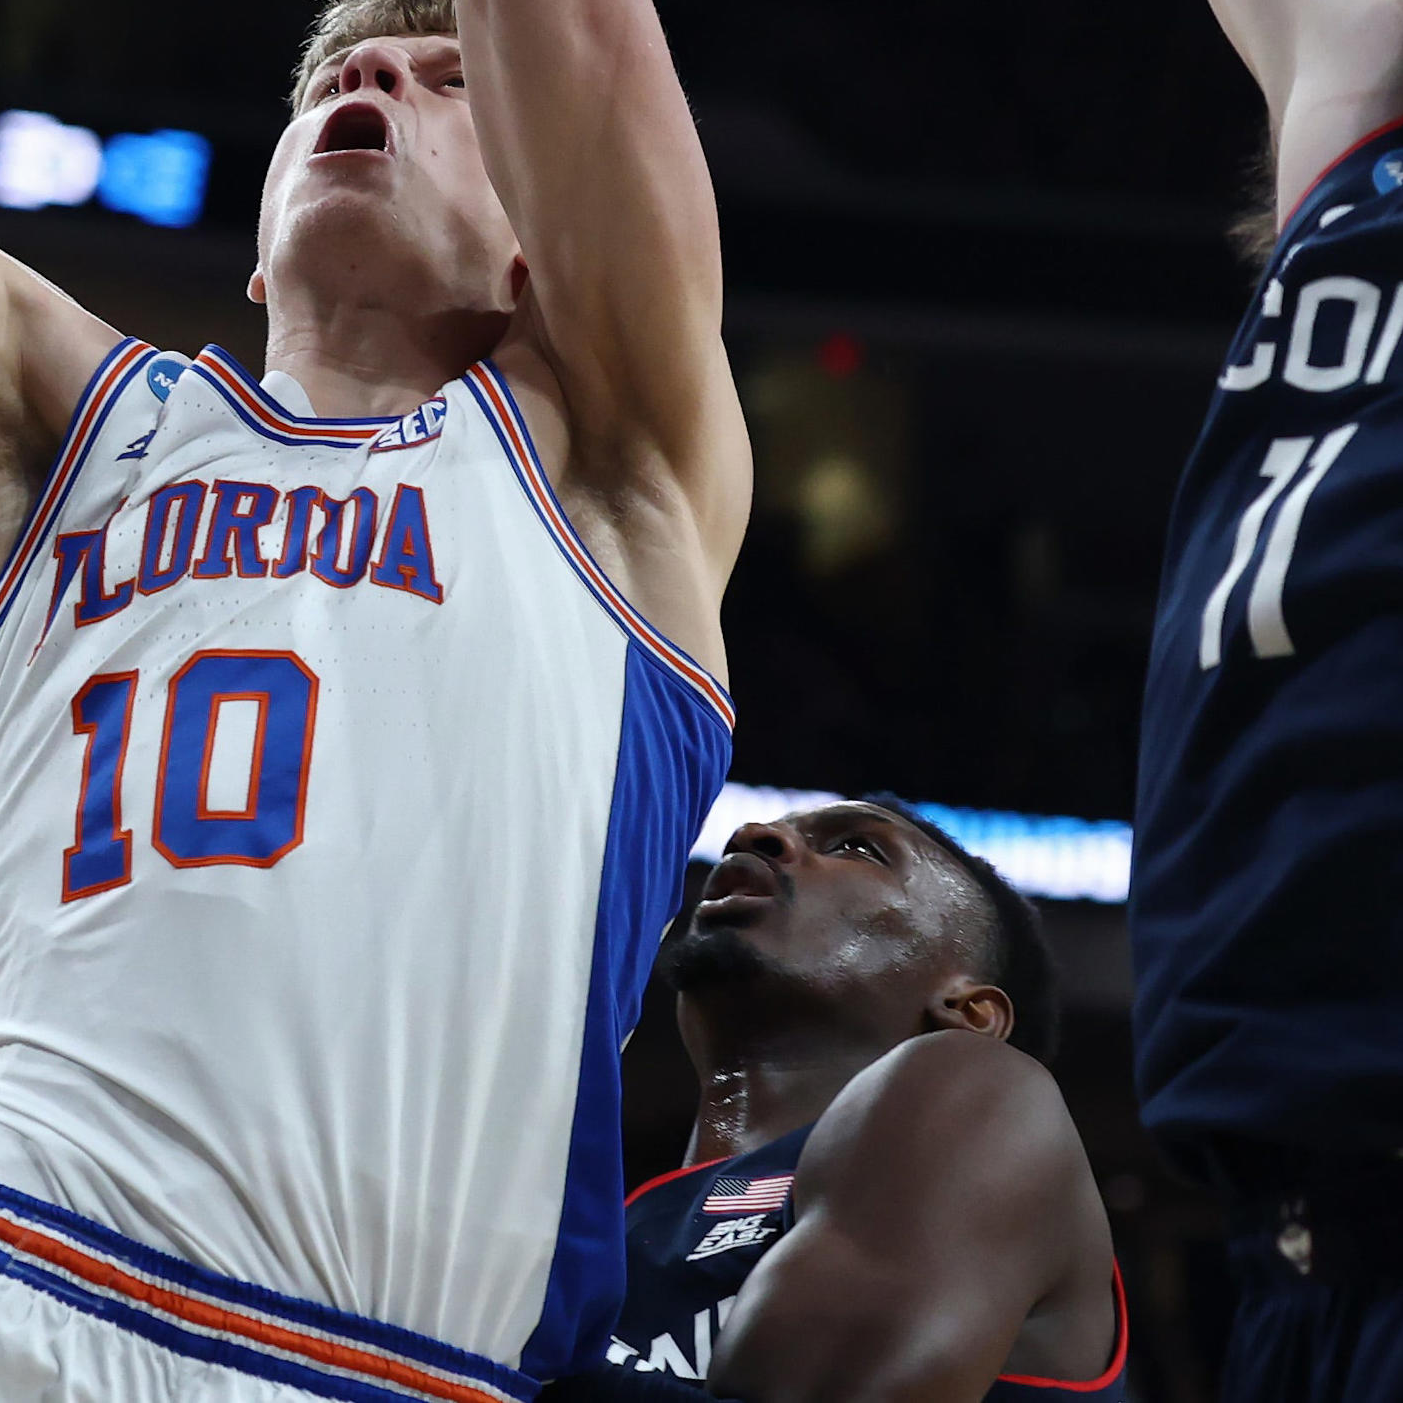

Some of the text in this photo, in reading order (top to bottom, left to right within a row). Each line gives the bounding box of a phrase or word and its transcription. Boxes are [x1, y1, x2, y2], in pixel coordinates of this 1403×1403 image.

[377, 401, 446, 448] SEC
[1200, 423, 1359, 671] 11
[62, 649, 320, 904] 10
[693, 1227, 778, 1253] EAST
[705, 1213, 768, 1237] BIG
